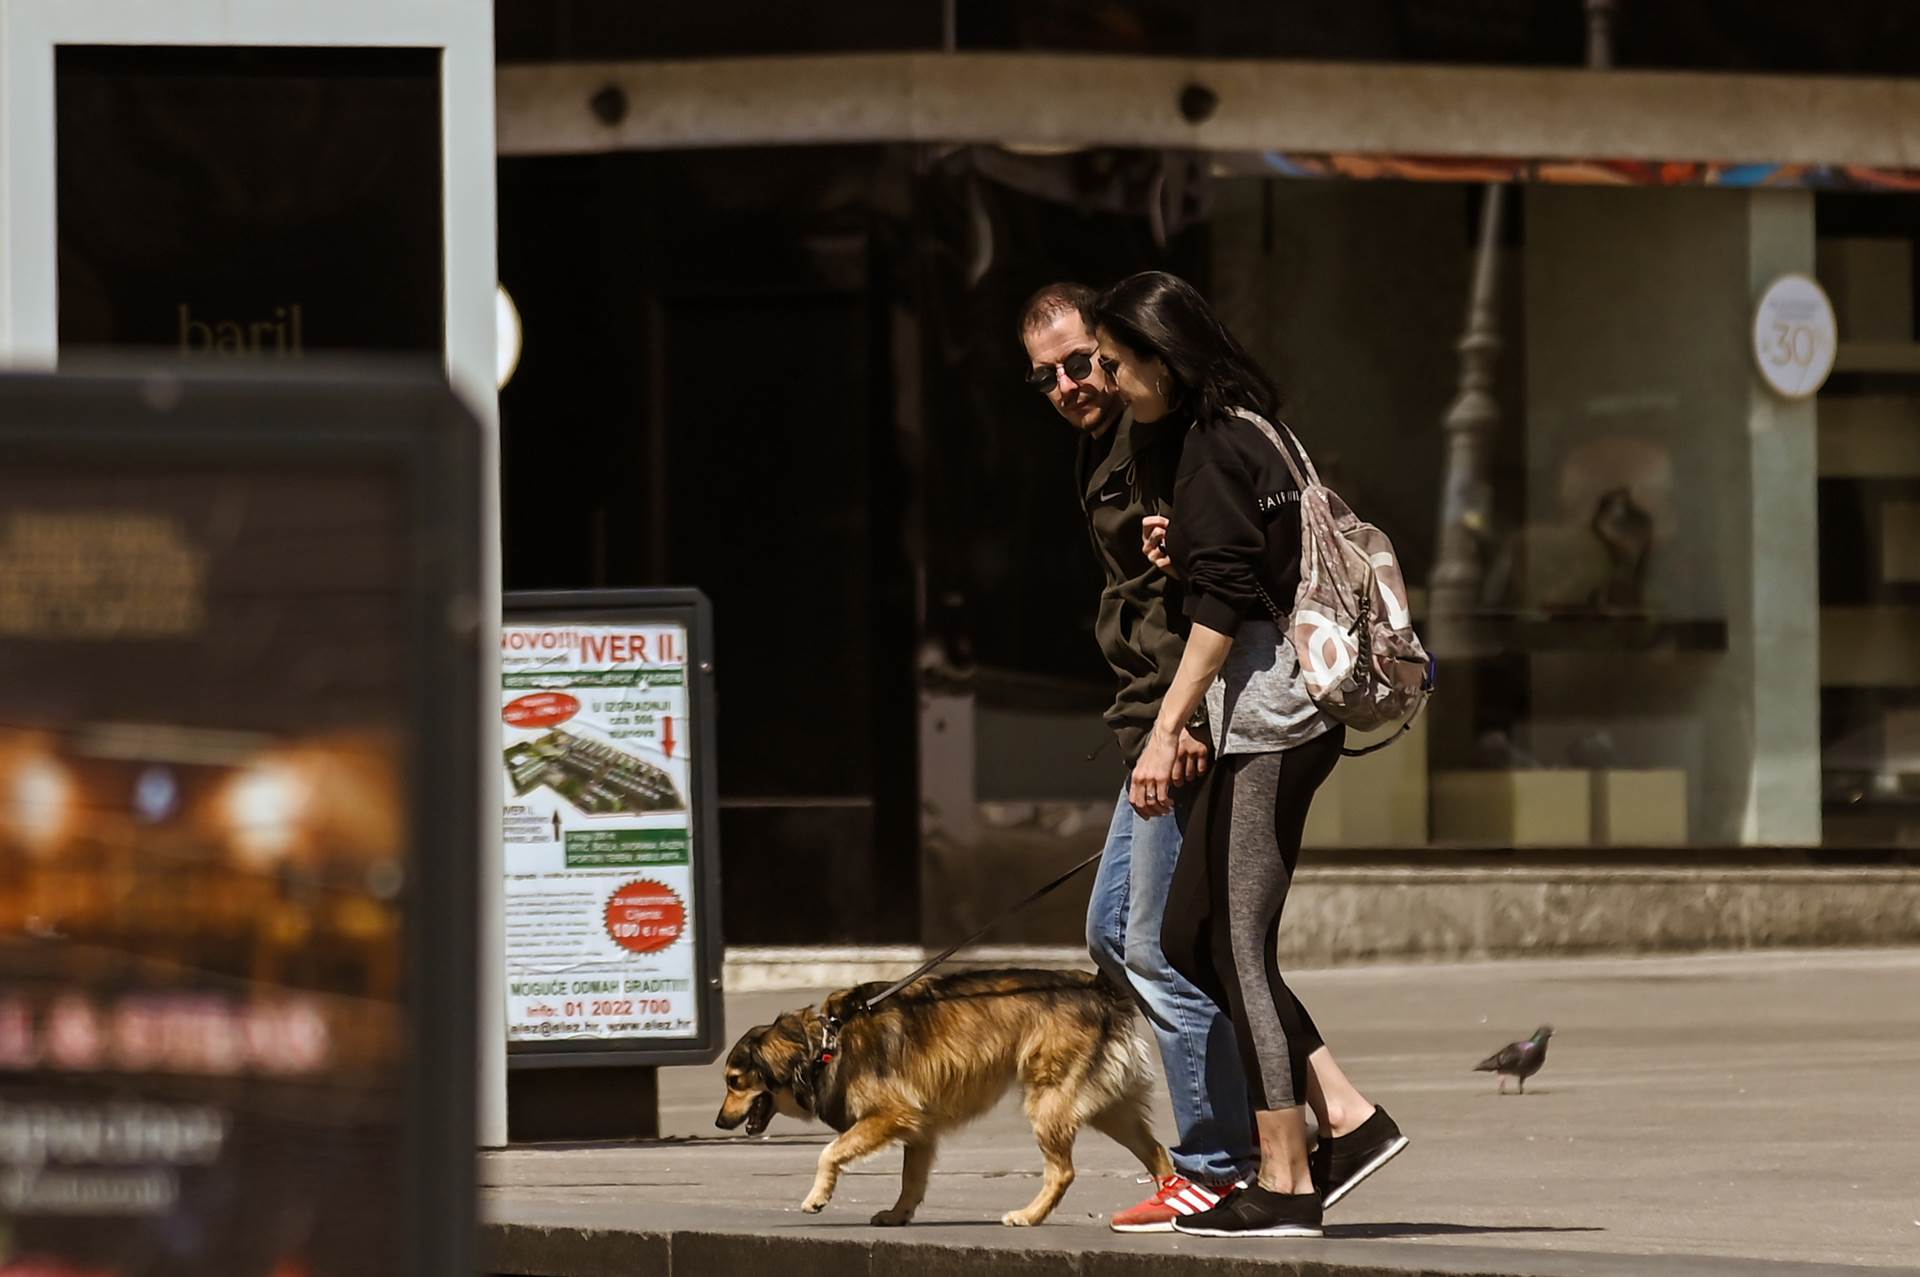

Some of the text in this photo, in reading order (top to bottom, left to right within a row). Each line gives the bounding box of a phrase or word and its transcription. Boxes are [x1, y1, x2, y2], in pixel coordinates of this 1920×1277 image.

[581, 634, 649, 663] IVER
[564, 1001, 583, 1017] 01
[592, 1000, 632, 1016] 2022
[639, 999, 671, 1015] 700
